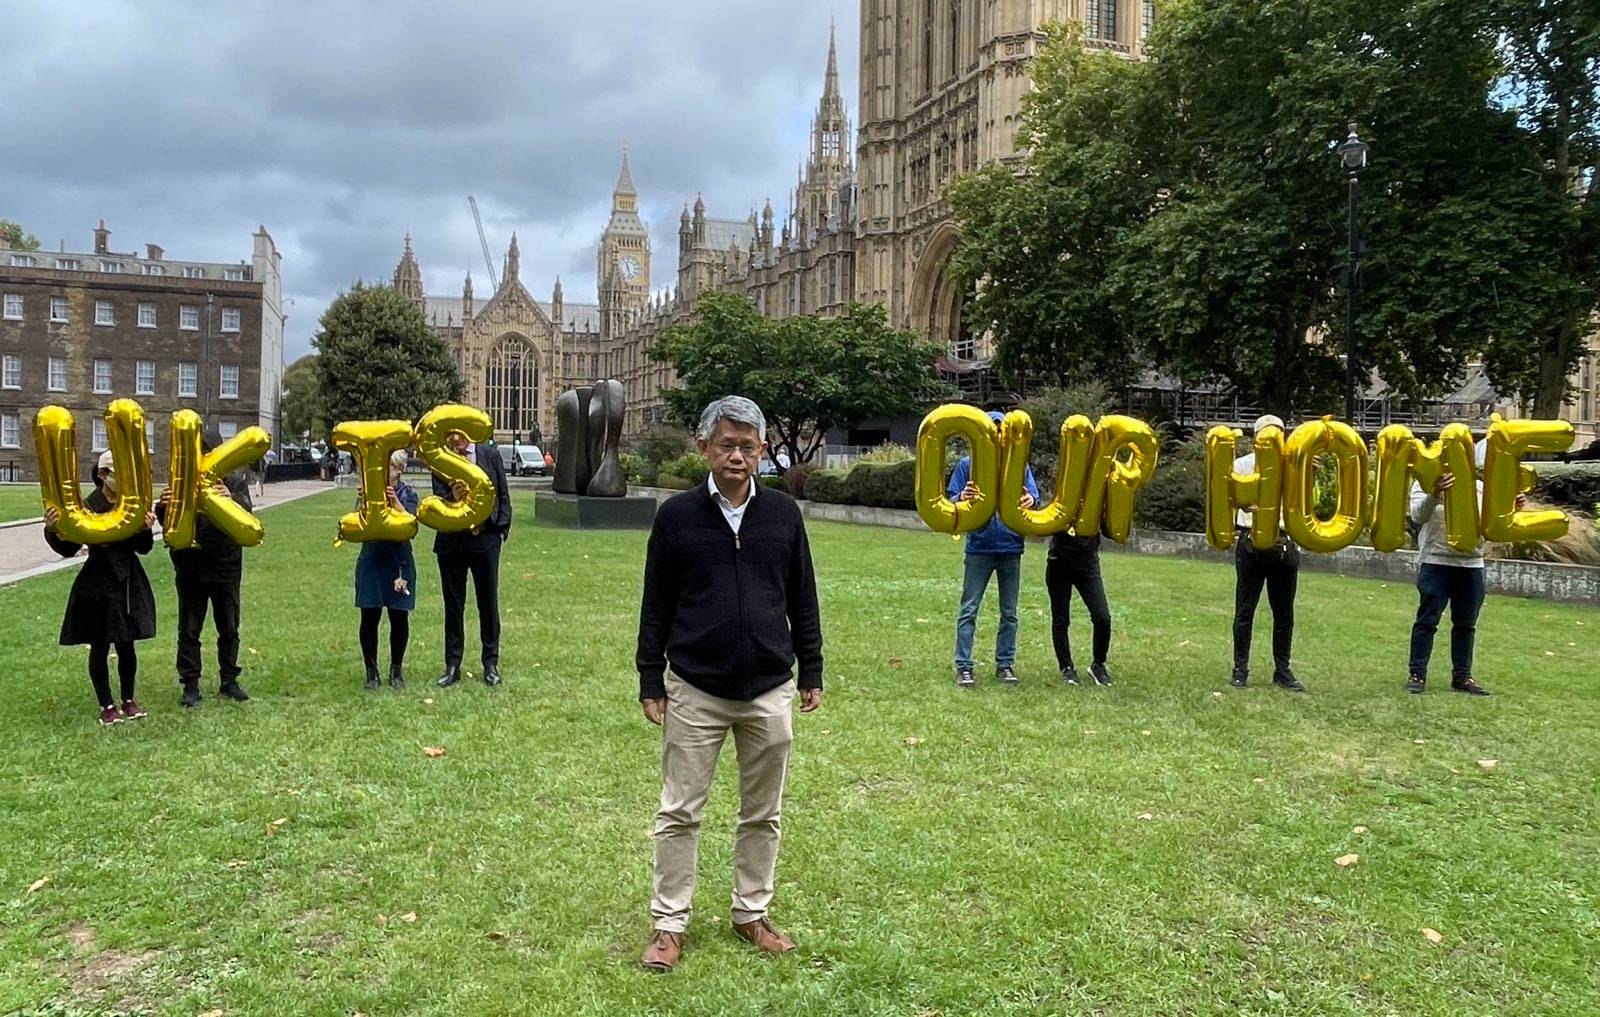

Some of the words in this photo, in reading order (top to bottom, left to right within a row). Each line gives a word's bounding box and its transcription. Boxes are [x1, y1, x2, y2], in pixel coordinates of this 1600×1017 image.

[33, 398, 272, 549] UK
[332, 404, 496, 546] IS
[915, 403, 1158, 544] OUR
[1206, 412, 1575, 552] HOME
